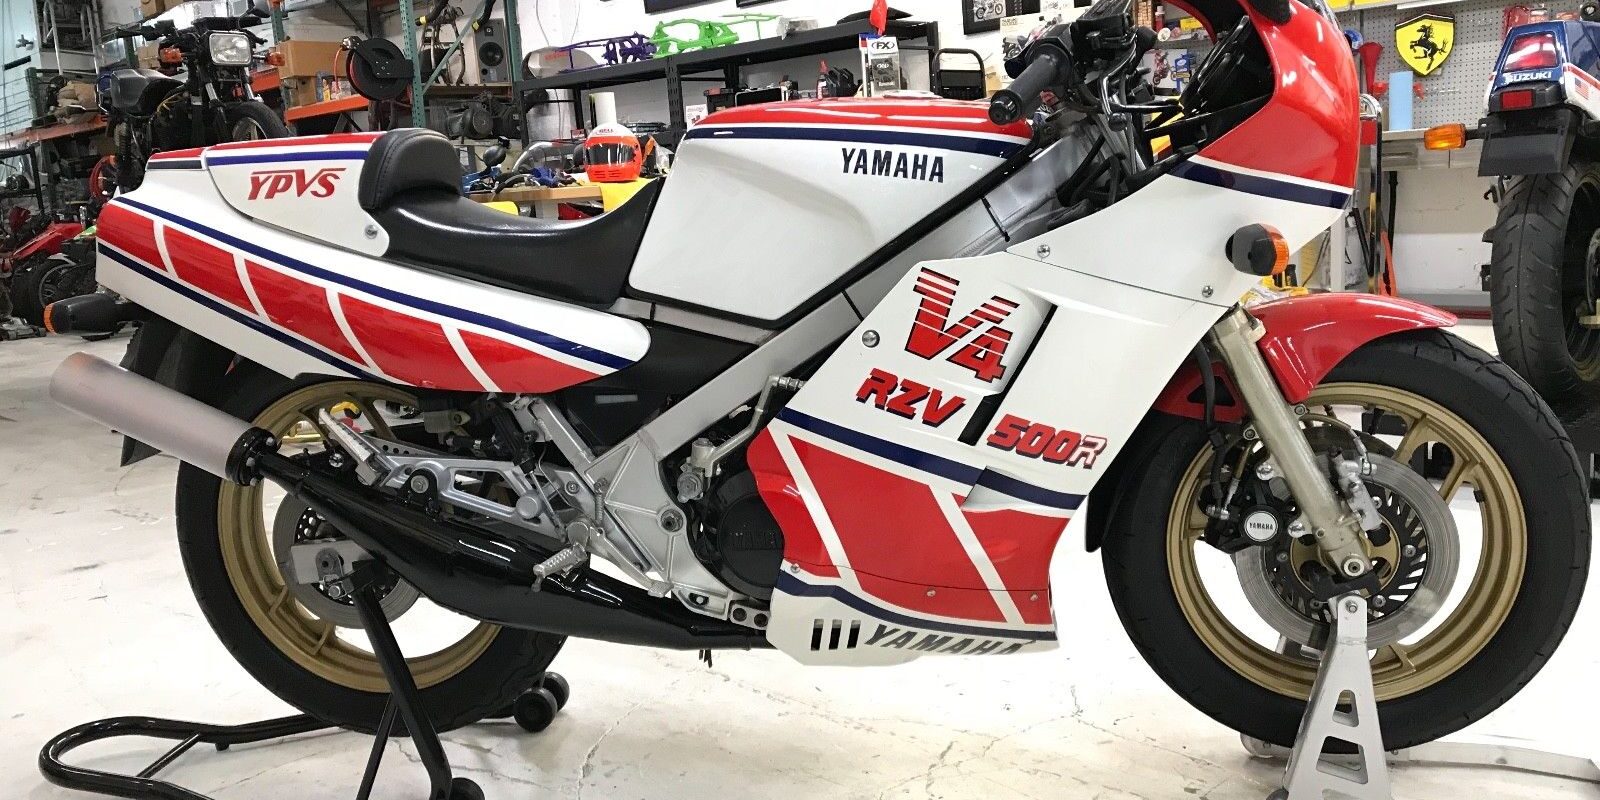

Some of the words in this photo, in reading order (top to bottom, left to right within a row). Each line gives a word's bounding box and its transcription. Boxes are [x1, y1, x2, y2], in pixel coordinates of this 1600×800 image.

[1503, 71, 1552, 84] SUZUKI
[842, 147, 944, 183] YAMAHA
[248, 168, 347, 200] YPVS
[904, 266, 1020, 383] V4
[856, 367, 967, 428] RZV
[986, 413, 1108, 469] 500R
[1249, 522, 1273, 530] YAMAHA
[864, 623, 1037, 656] YAMAHA
